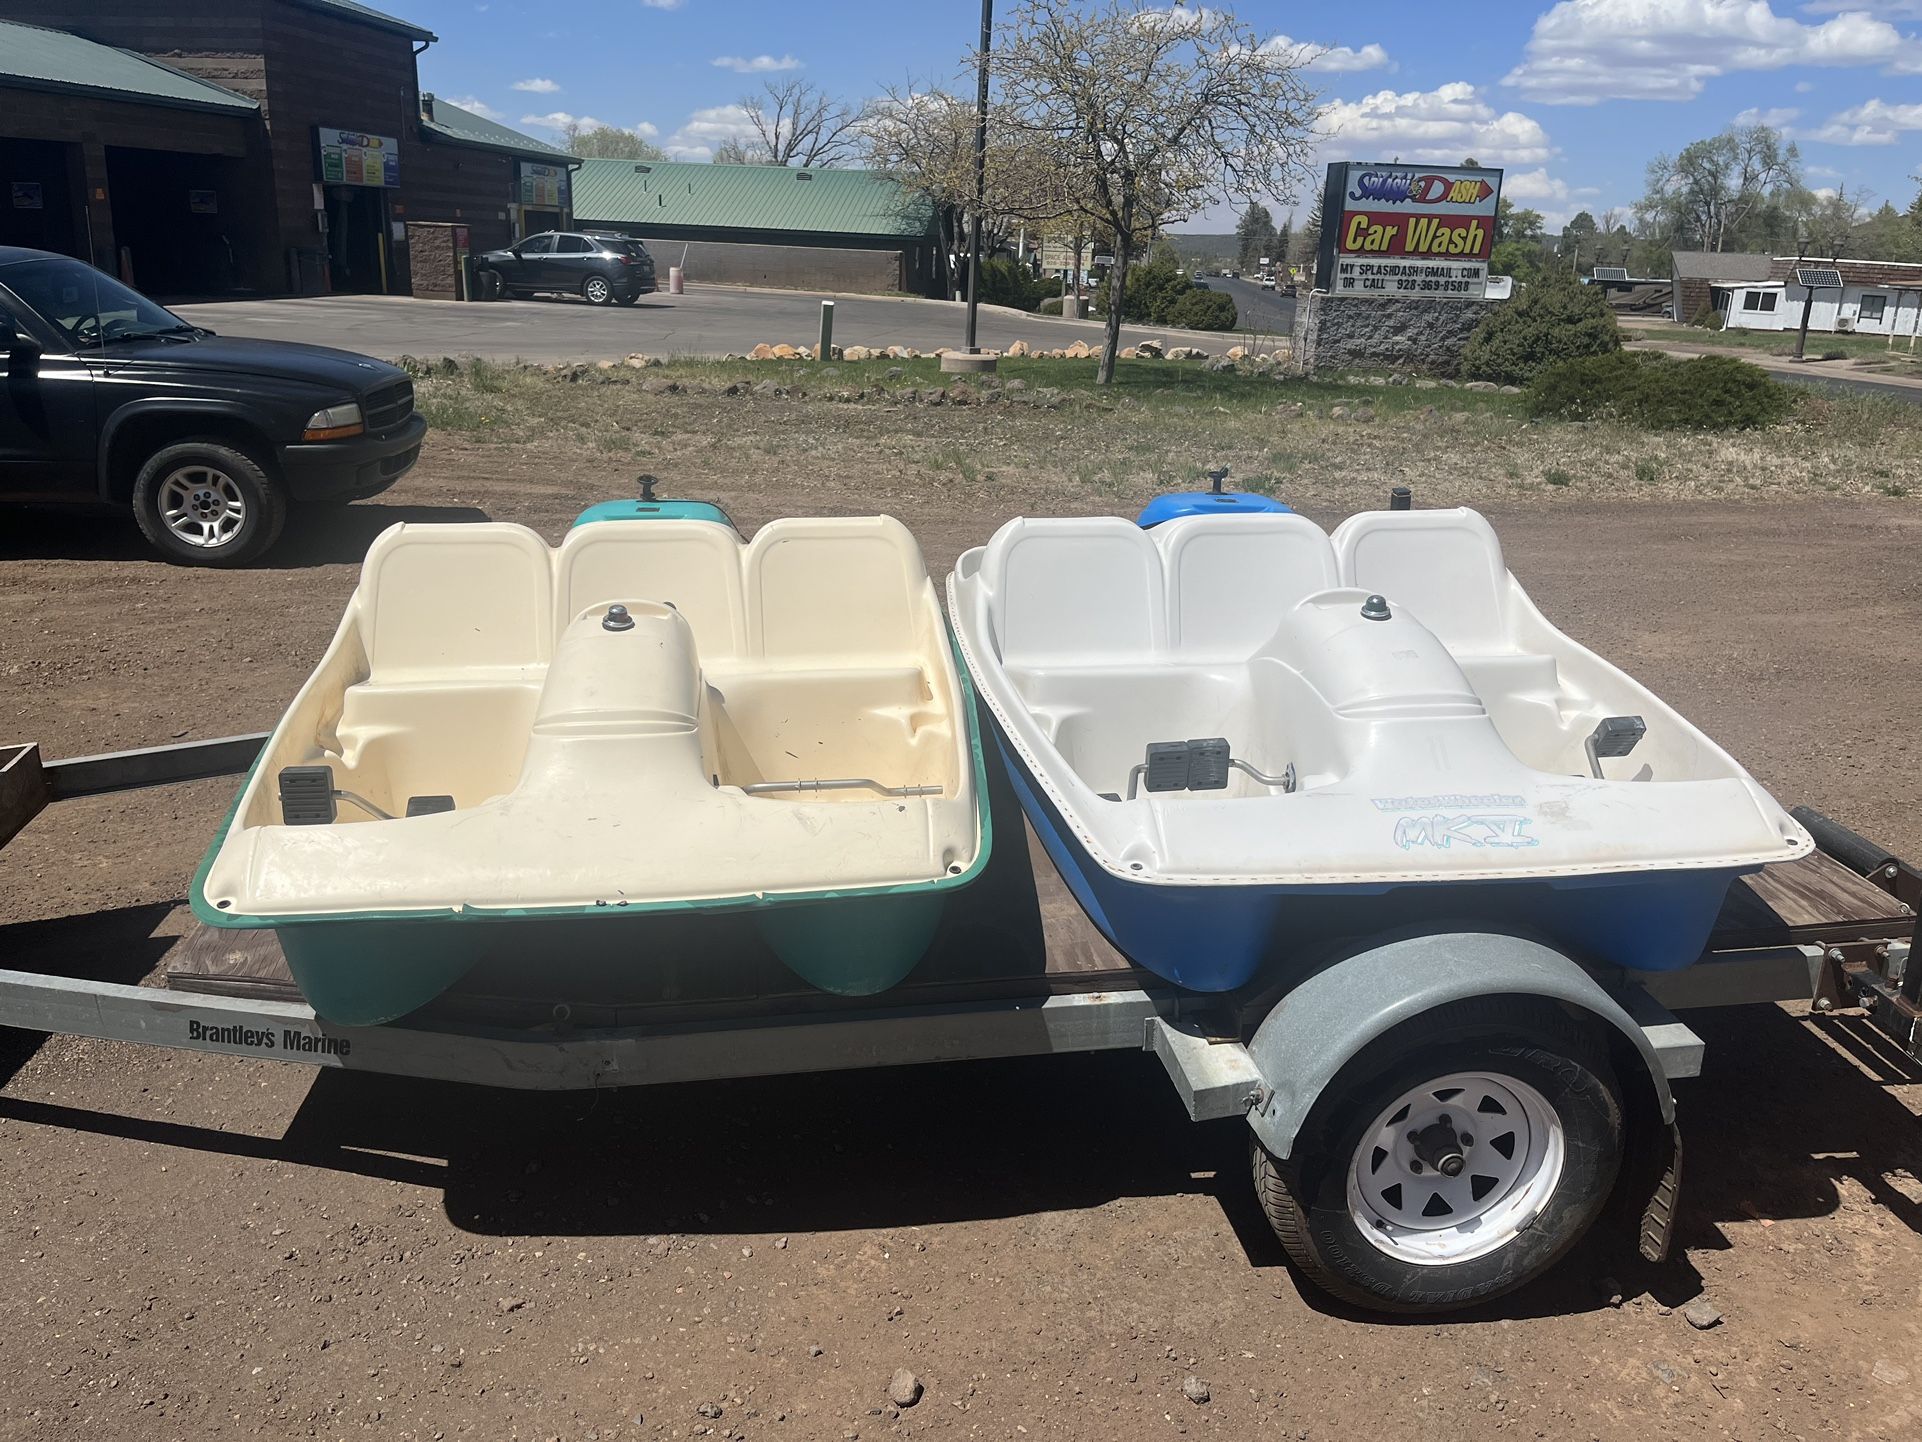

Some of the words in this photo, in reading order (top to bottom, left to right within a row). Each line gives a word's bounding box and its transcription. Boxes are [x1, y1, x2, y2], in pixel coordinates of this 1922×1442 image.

[1345, 215, 1398, 251] Car
[1405, 217, 1485, 254] Wash
[1340, 263, 1355, 275] MY
[1343, 277, 1355, 288] OR
[1363, 277, 1386, 290] CALL
[1397, 279, 1470, 292] 928-369-8588
[189, 1020, 275, 1048] Brantley's
[283, 1029, 351, 1055] Marine
